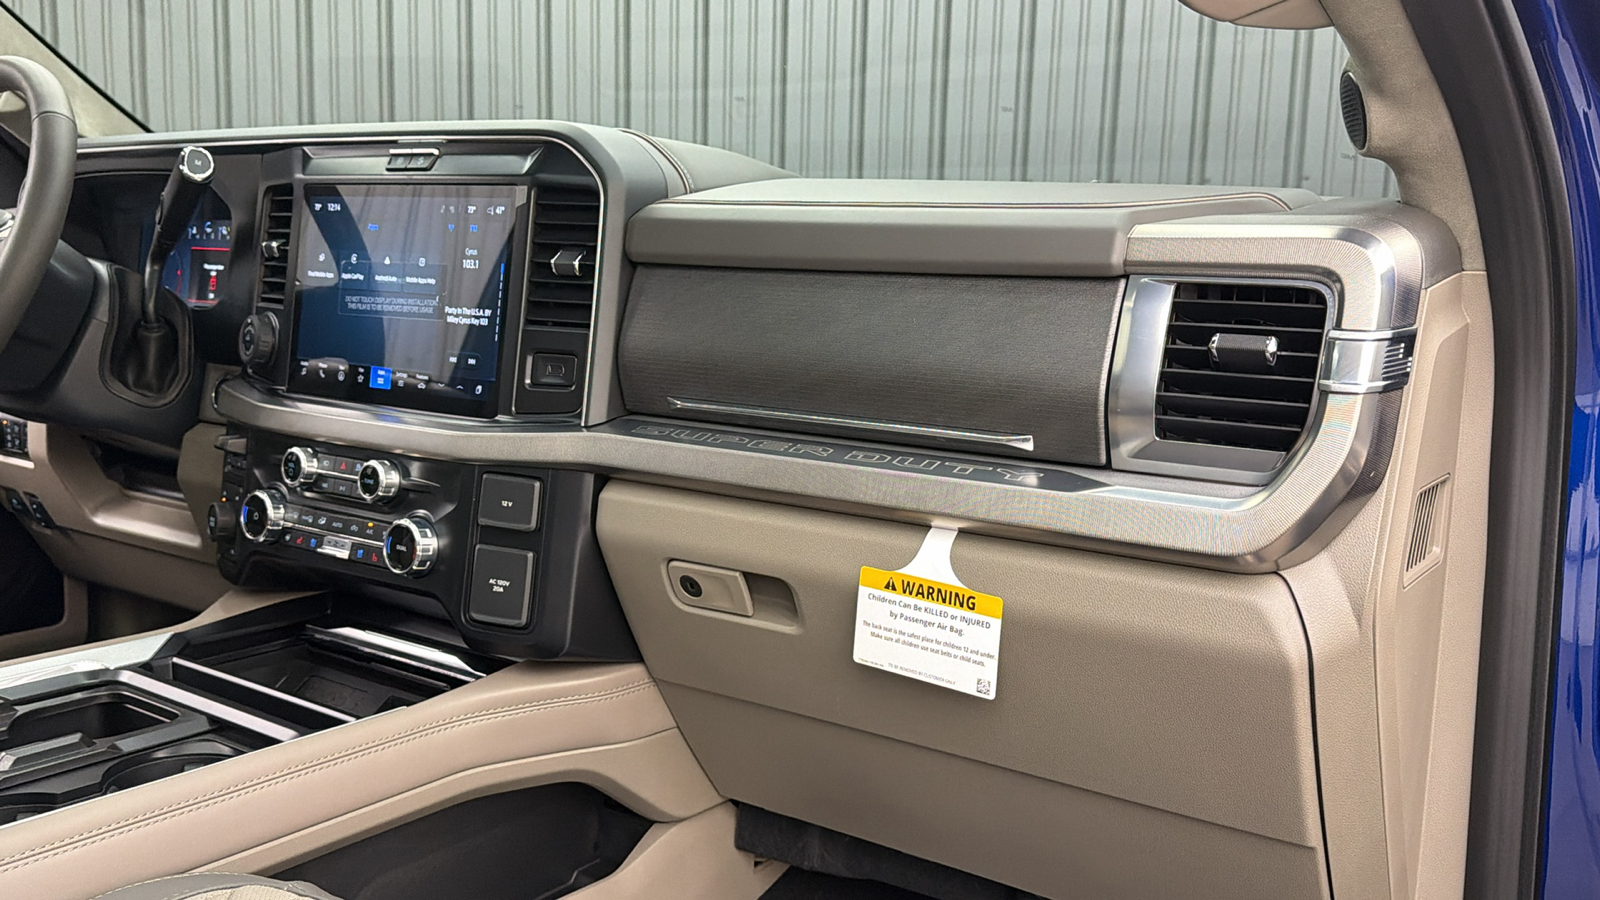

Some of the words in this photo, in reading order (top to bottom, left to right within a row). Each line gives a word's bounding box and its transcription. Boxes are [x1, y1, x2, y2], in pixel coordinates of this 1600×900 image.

[465, 247, 478, 256] Cyrus
[462, 259, 479, 269] 103.1
[391, 297, 407, 305] DURING
[383, 304, 403, 312] REMOVED
[403, 305, 419, 313] BEFORE
[419, 306, 434, 314] USAGE
[444, 306, 457, 315] Party
[462, 307, 471, 315] The
[485, 309, 492, 317] BY
[446, 315, 459, 325] Miley
[458, 316, 471, 325] Cyrus
[470, 317, 480, 326] Key
[480, 318, 488, 326] 103
[631, 425, 834, 457] SUPER
[844, 450, 1045, 482] DUTY
[396, 544, 407, 552] DUAL
[497, 579, 510, 587] 120V
[492, 585, 504, 593] 20A
[901, 579, 976, 611] WARNING
[868, 592, 897, 606] Children
[898, 600, 912, 610] Can
[913, 603, 923, 613] Be
[924, 606, 949, 619] KILLED
[950, 613, 958, 621] or
[960, 615, 991, 630] INJURED
[889, 610, 898, 620] by
[899, 612, 936, 628] Passenger
[937, 622, 947, 631] Air
[949, 625, 965, 637] Bag.
[872, 622, 882, 630] back
[906, 632, 921, 640] safest
[921, 635, 934, 643] place
[942, 641, 962, 651] children
[980, 652, 996, 660] under.
[870, 631, 883, 639] Make
[901, 639, 920, 649] children
[940, 649, 952, 658] belts
[959, 655, 971, 663] child
[972, 659, 986, 667] seats.
[899, 666, 917, 675] REMOVED
[923, 672, 945, 682] CUSTOMER
